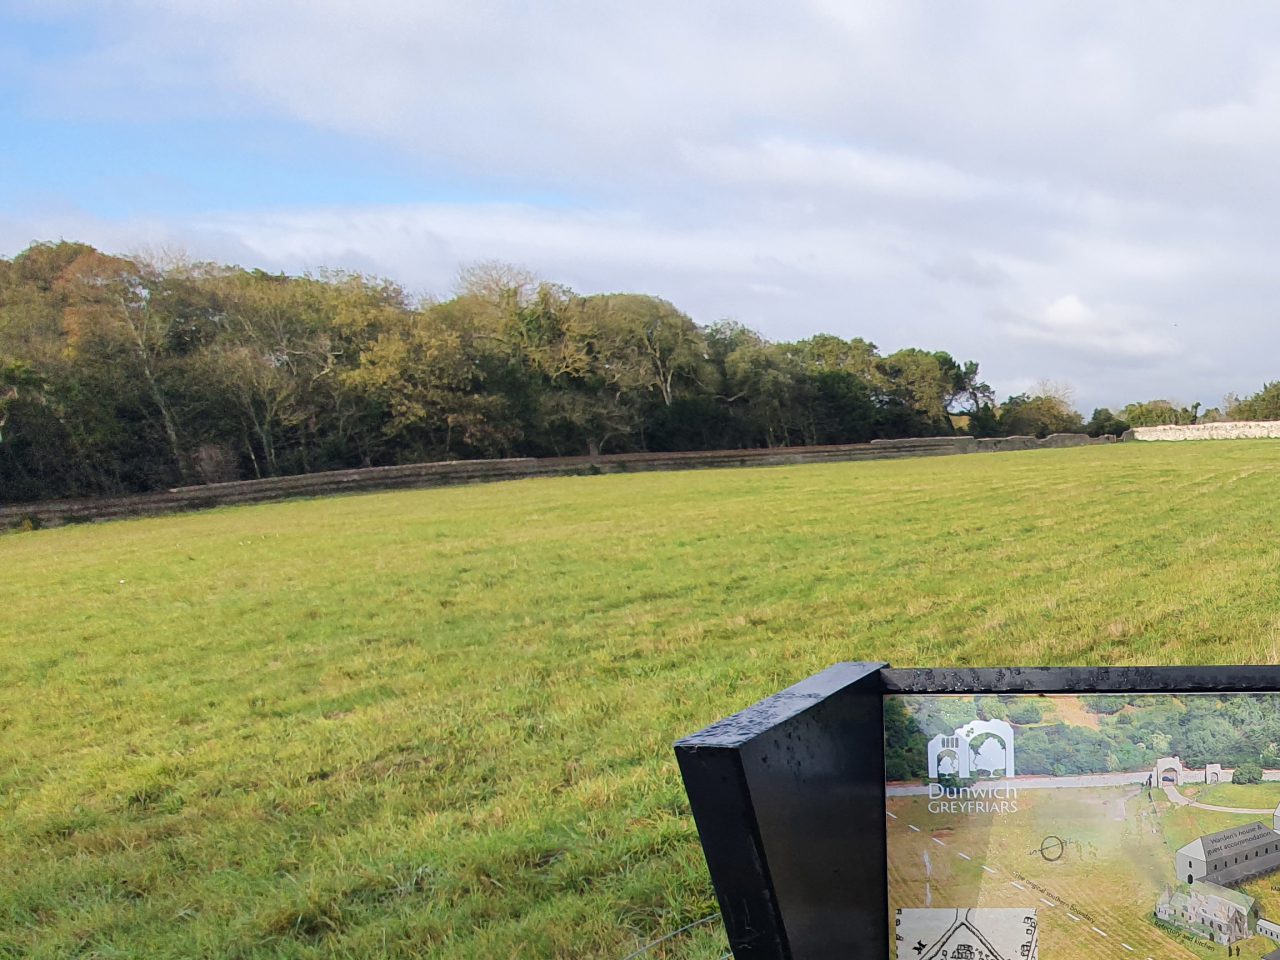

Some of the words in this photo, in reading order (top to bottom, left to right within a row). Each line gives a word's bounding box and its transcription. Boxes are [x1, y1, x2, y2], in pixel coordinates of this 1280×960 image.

[929, 783, 1017, 799] Dunwich
[928, 801, 1018, 813] GREYFRIARS
[1207, 846, 1222, 856] guest
[1224, 832, 1271, 850] accommodation
[1210, 832, 1238, 844] Warden's
[1238, 827, 1256, 836] house
[1155, 920, 1182, 937] Refectory
[1183, 934, 1193, 942] and
[1194, 939, 1215, 951] kitchen
